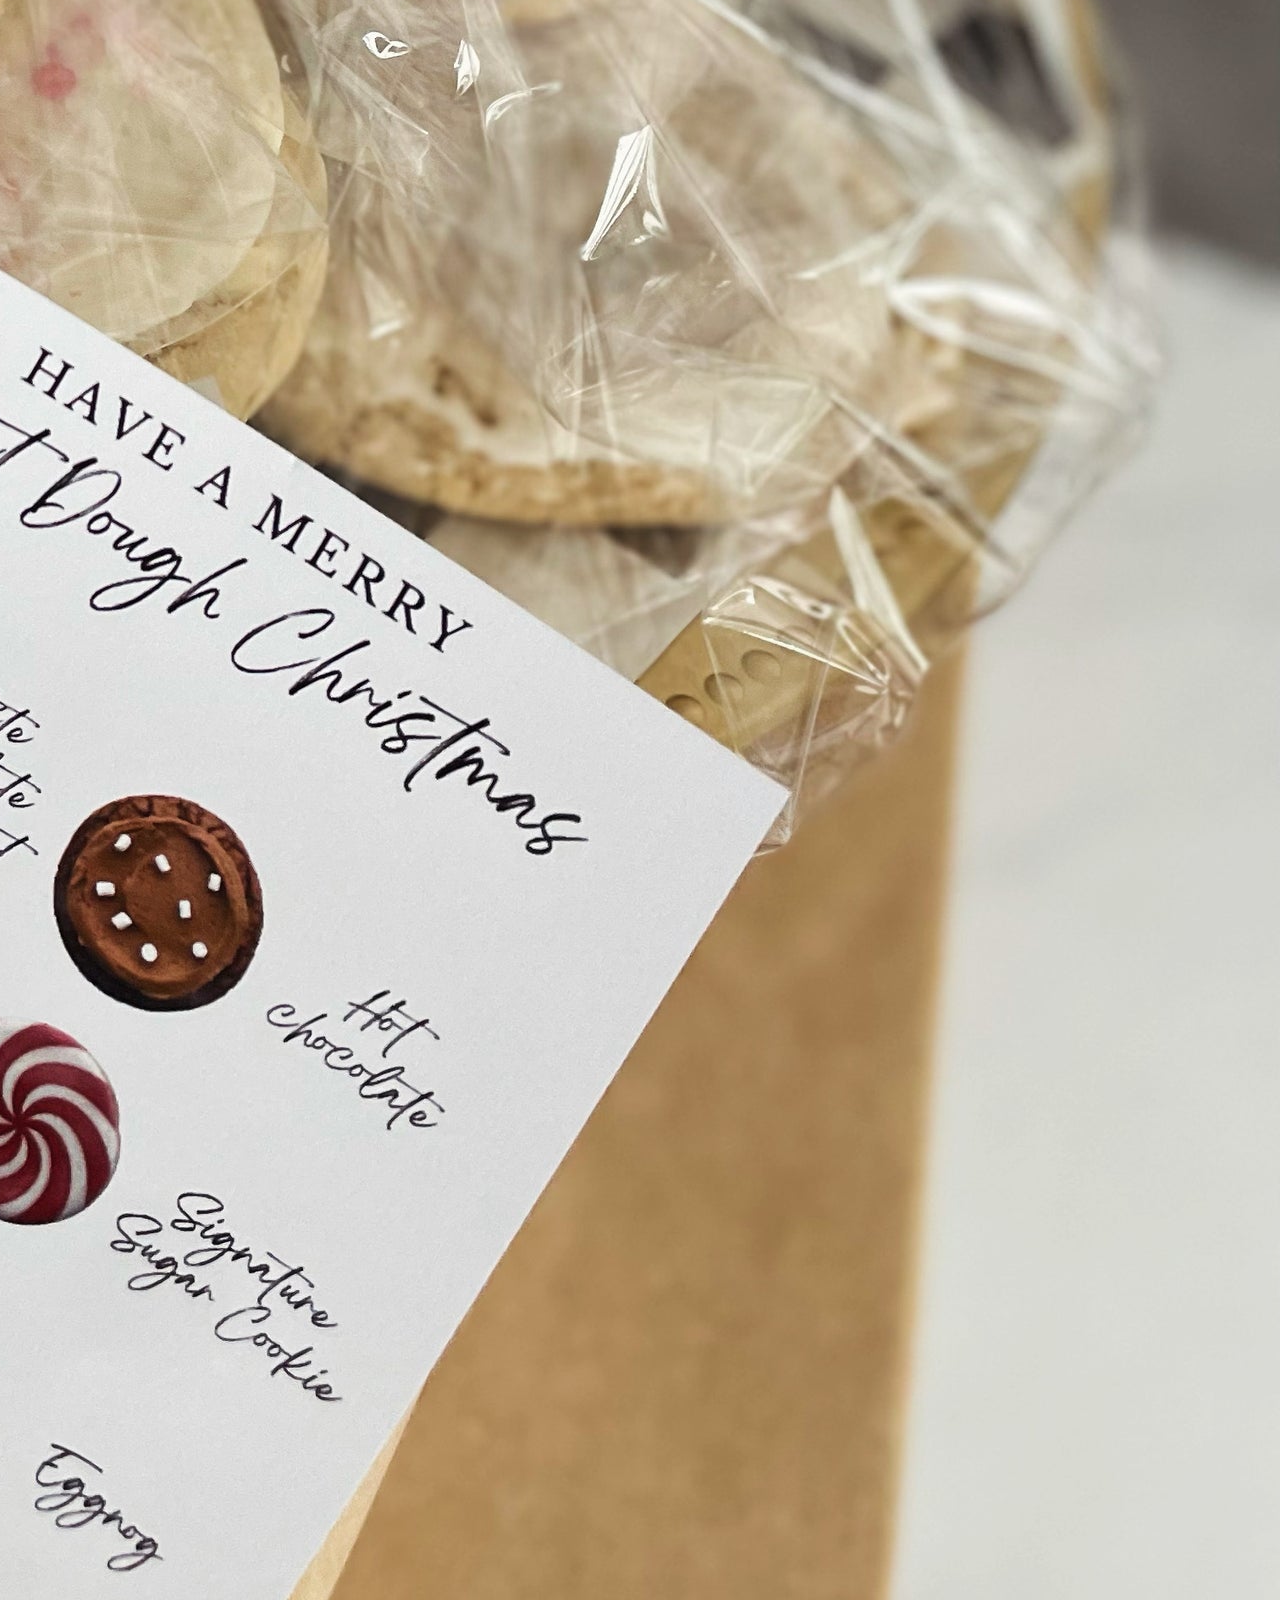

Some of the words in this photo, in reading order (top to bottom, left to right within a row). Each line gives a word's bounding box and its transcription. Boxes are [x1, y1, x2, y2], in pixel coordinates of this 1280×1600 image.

[21, 346, 186, 471] HAVE
[194, 465, 233, 510] A
[251, 493, 474, 654] MERRY
[20, 457, 248, 620] Dough
[231, 608, 590, 856] Christmas
[342, 989, 440, 1059] Hot
[110, 1213, 215, 1303] Sugar
[214, 1305, 343, 1402] Cookie
[170, 1192, 339, 1330] Signature
[34, 1442, 164, 1573] Eggnog
